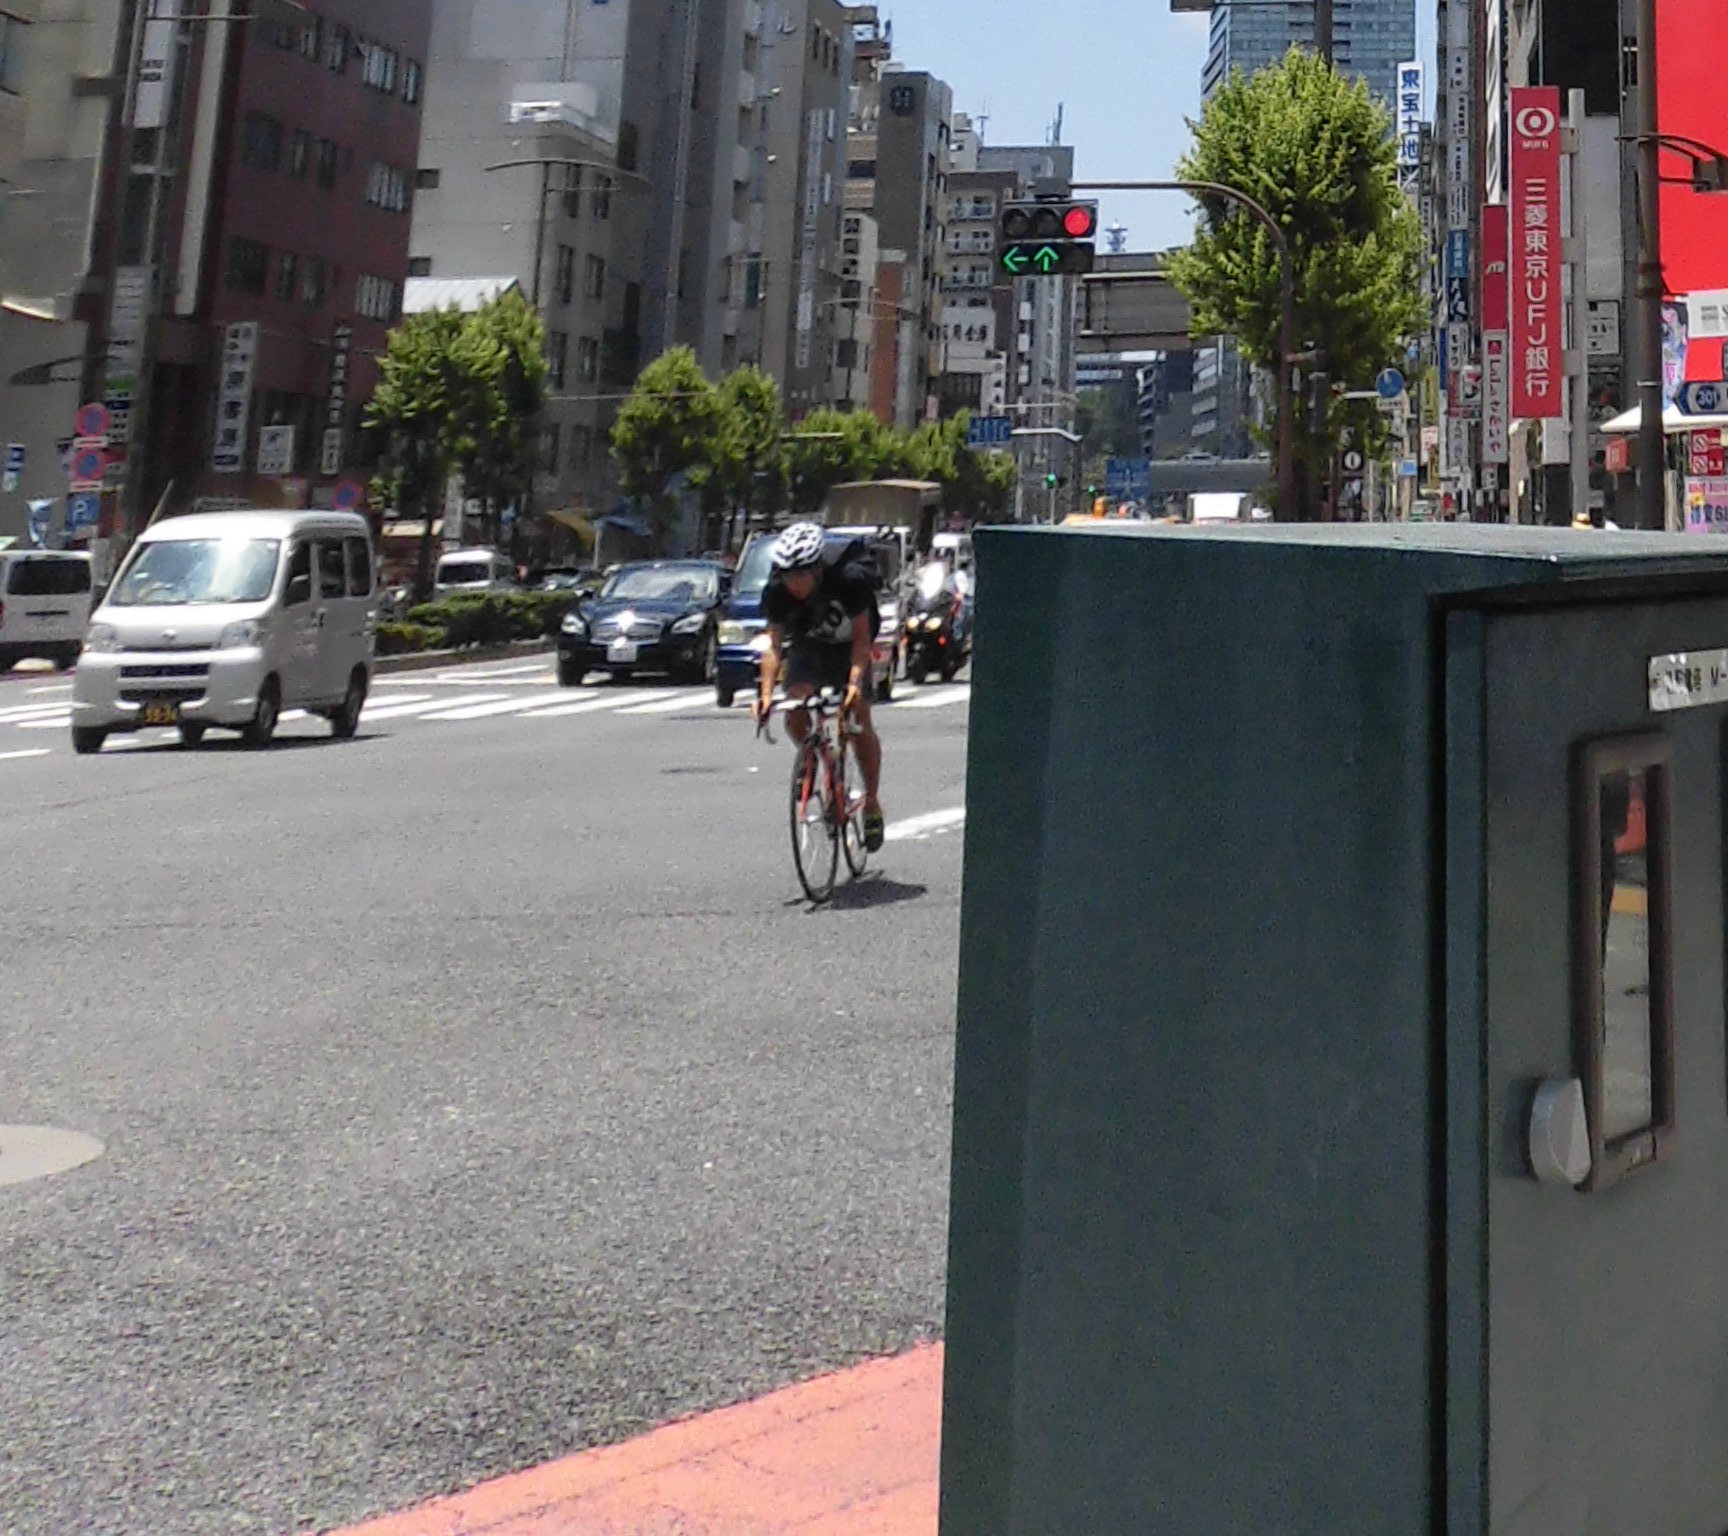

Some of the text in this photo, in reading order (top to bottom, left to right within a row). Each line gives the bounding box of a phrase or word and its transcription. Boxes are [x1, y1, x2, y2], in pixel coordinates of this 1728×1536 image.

[1401, 68, 1421, 160] 東宝土地
[1524, 178, 1550, 398] 三菱東京UFJ銀行
